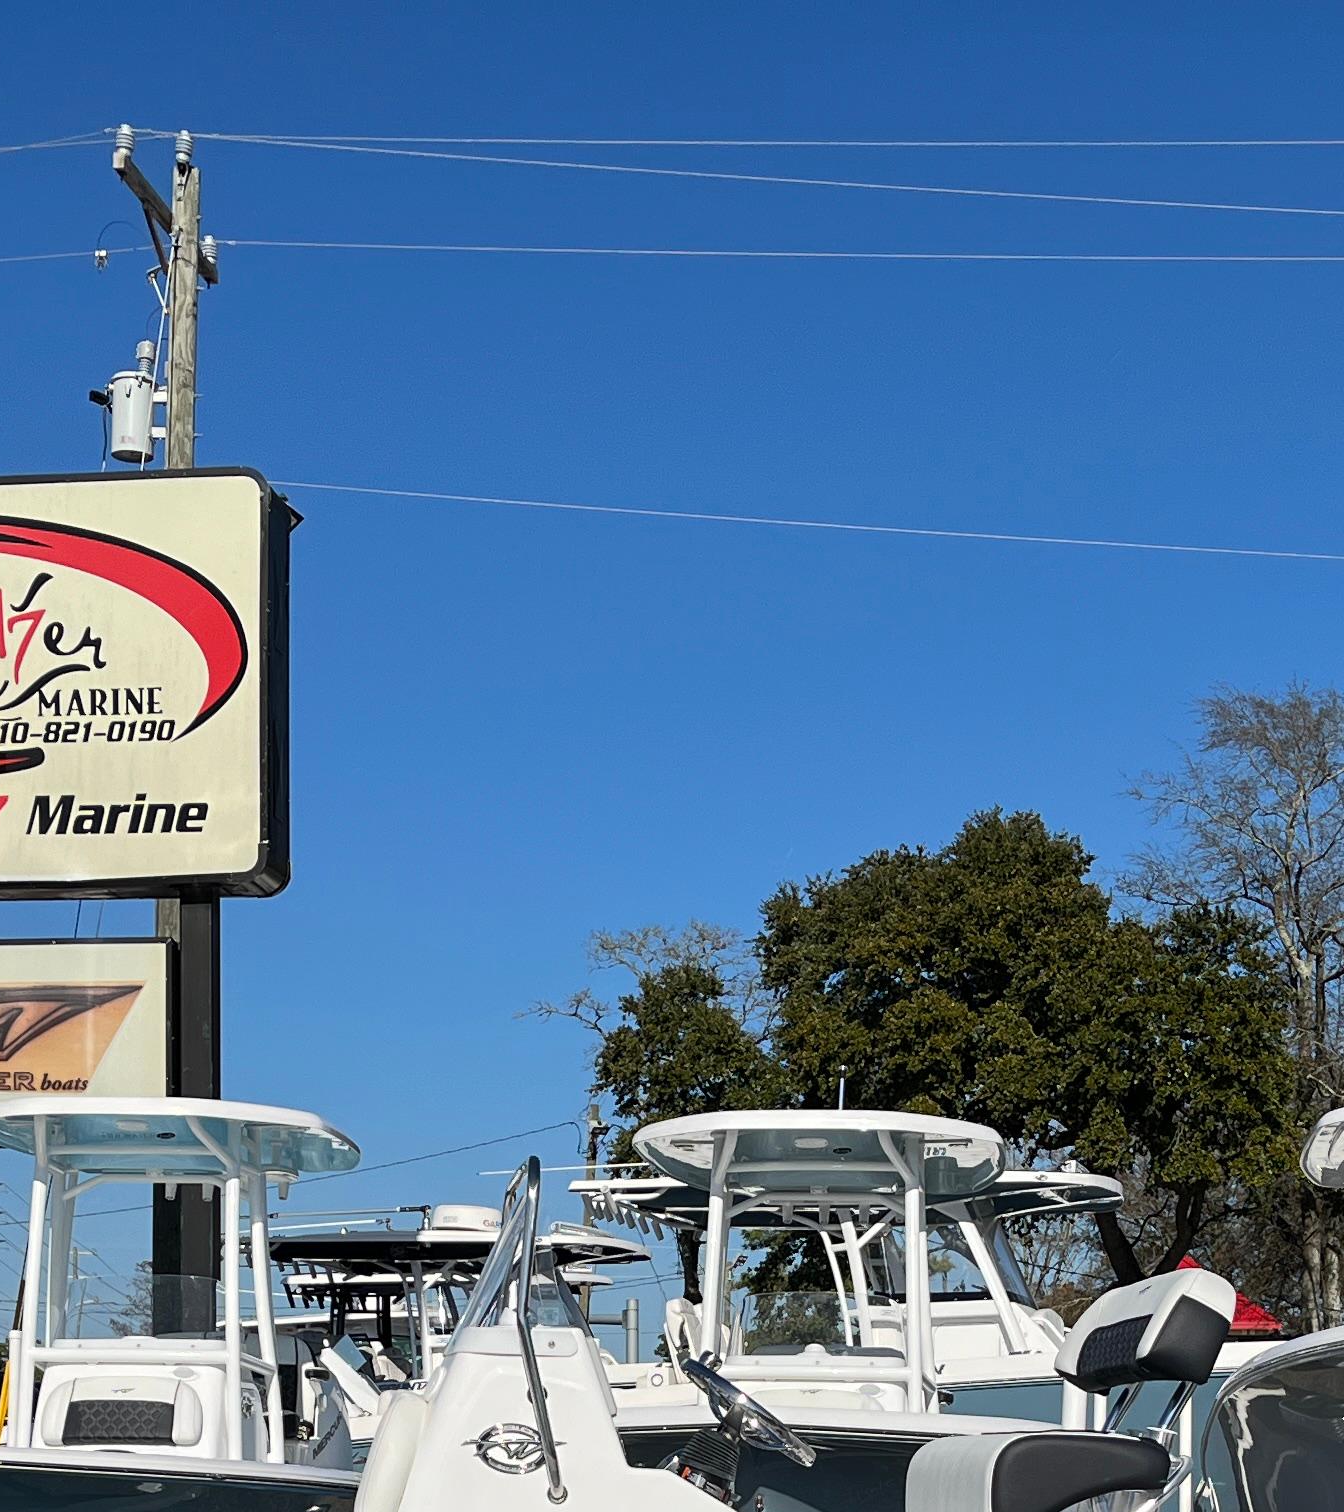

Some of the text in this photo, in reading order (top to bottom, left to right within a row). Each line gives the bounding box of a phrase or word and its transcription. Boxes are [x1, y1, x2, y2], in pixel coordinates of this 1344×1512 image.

[38, 687, 163, 717] MARINE
[26, 793, 209, 834] Marine
[41, 1073, 89, 1092] boats
